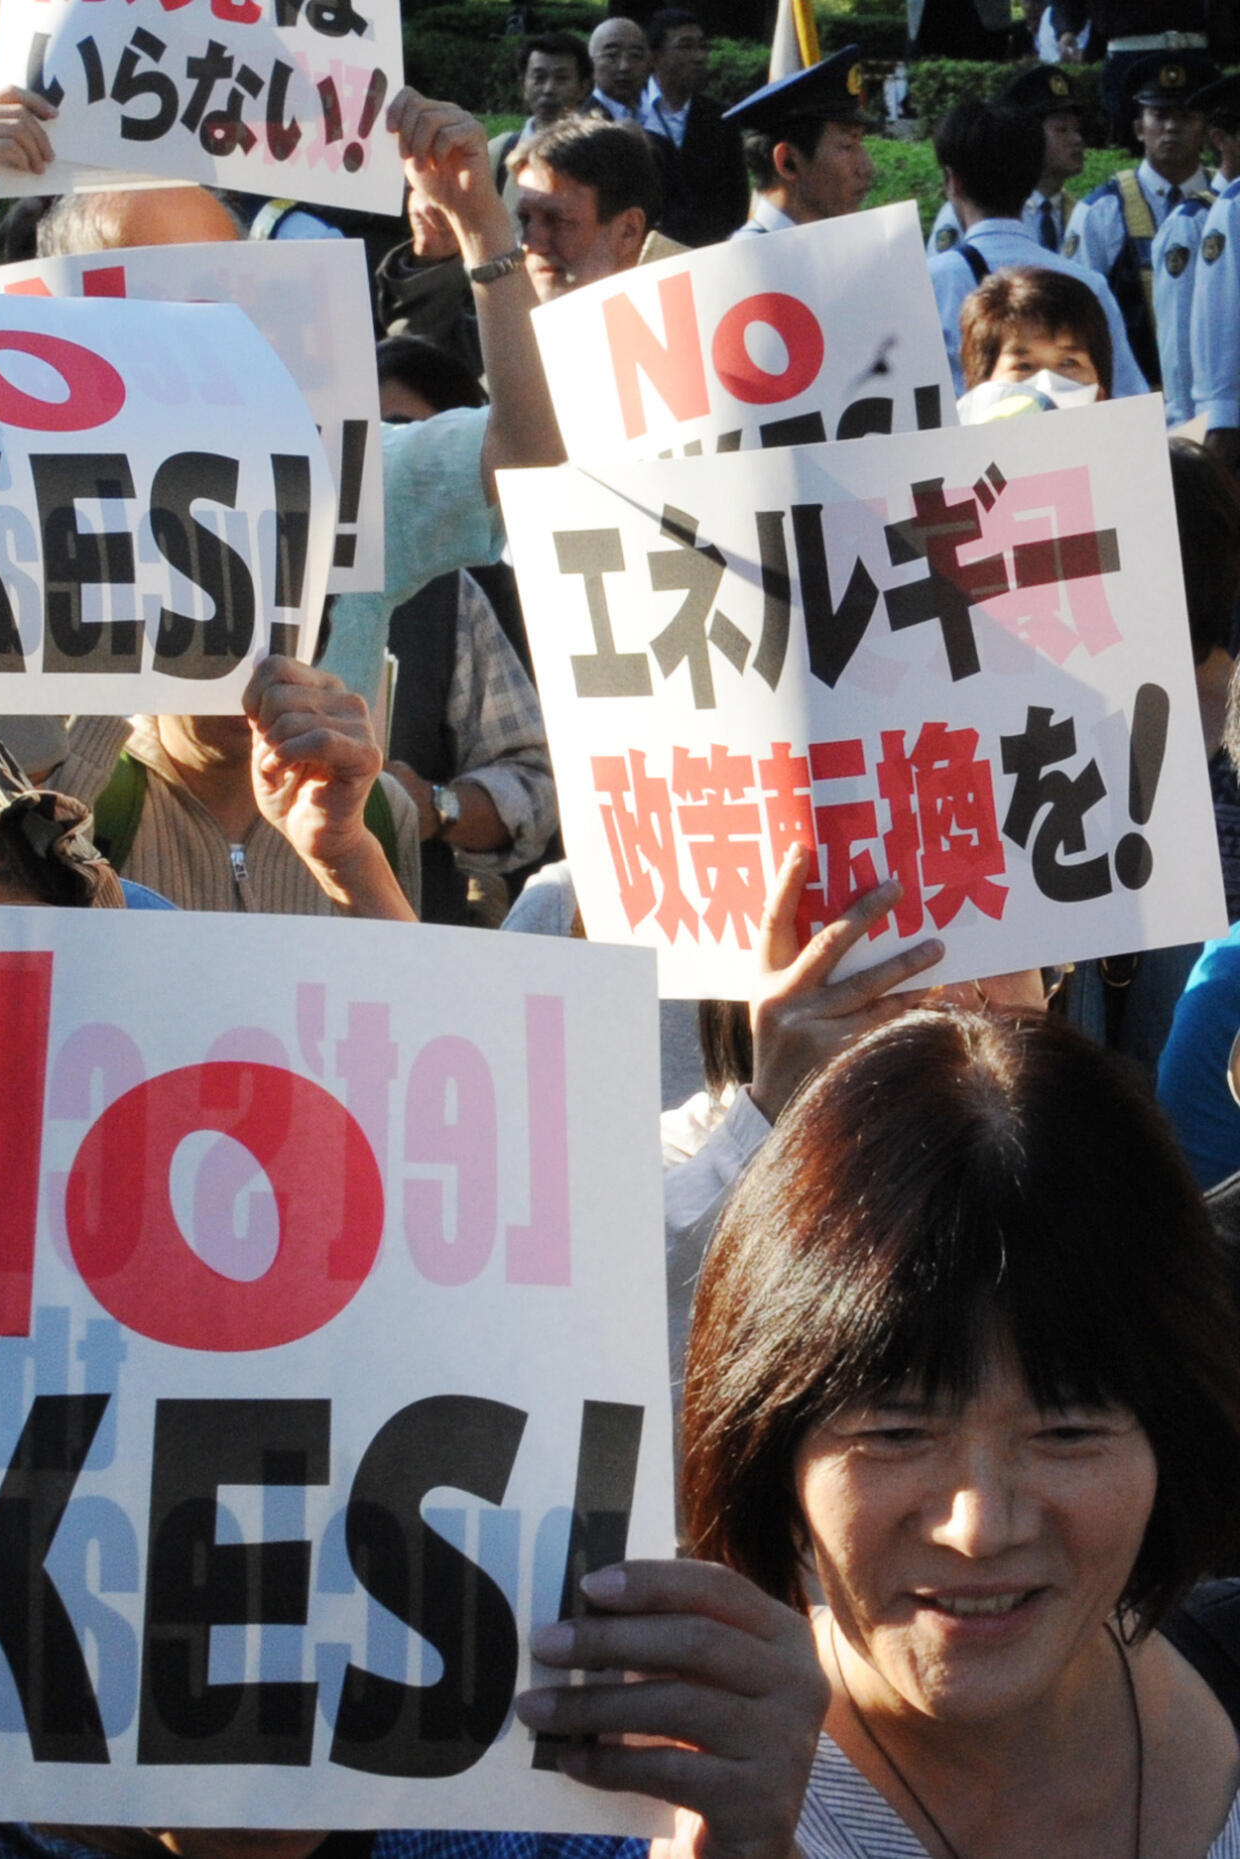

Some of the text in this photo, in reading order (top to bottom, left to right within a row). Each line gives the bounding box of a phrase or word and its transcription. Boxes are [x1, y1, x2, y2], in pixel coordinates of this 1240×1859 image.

[27, 26, 388, 173] いらない!
[551, 461, 1121, 709] エネルギー
[590, 683, 1170, 950] 政策転換を!
